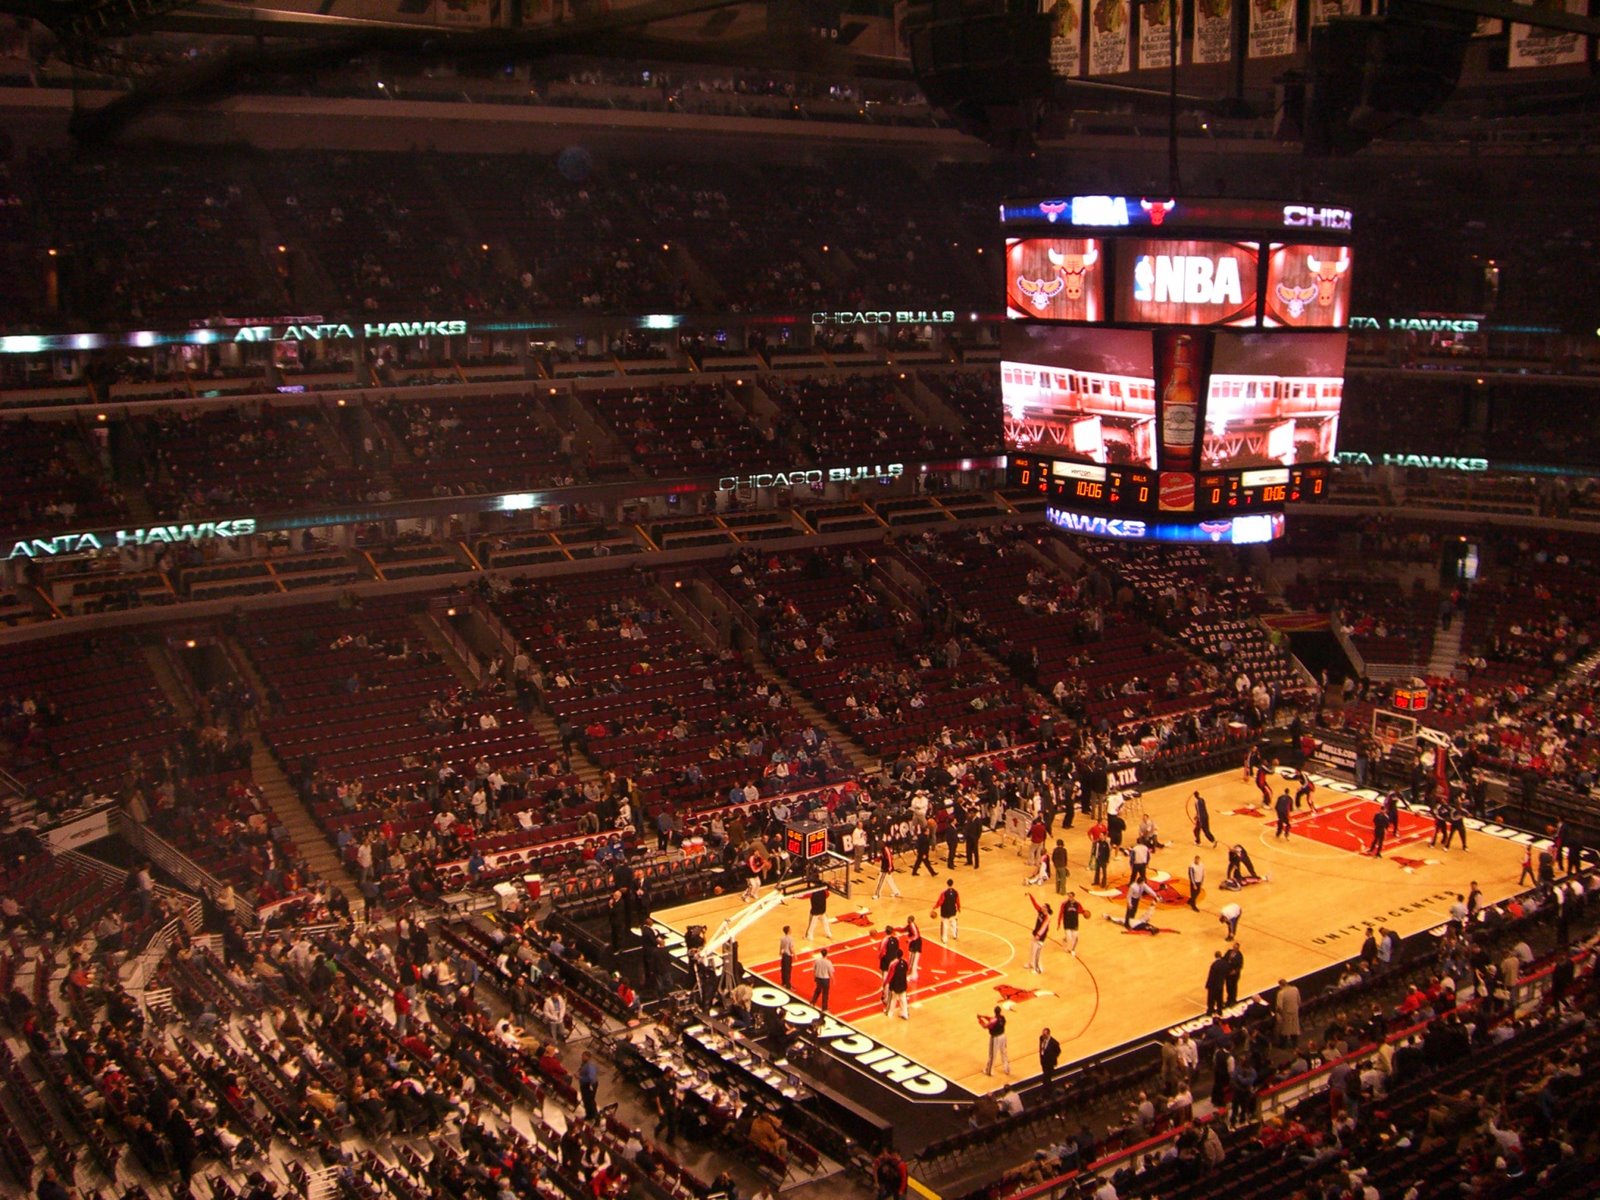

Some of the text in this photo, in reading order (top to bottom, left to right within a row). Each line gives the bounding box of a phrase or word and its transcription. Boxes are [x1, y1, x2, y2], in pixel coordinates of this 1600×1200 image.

[1156, 254, 1242, 306] NBA
[811, 310, 955, 325] CHICAGO BULLS
[1388, 318, 1480, 333] HAWKS
[364, 320, 467, 338] HAWKS
[1382, 453, 1489, 471] HAWKS
[718, 463, 903, 491] CHICAGO BULLS
[1076, 481, 1103, 499] 10:06
[1262, 485, 1287, 502] 10:06
[1049, 507, 1146, 537] HAWKS
[116, 518, 256, 547] HAWKS
